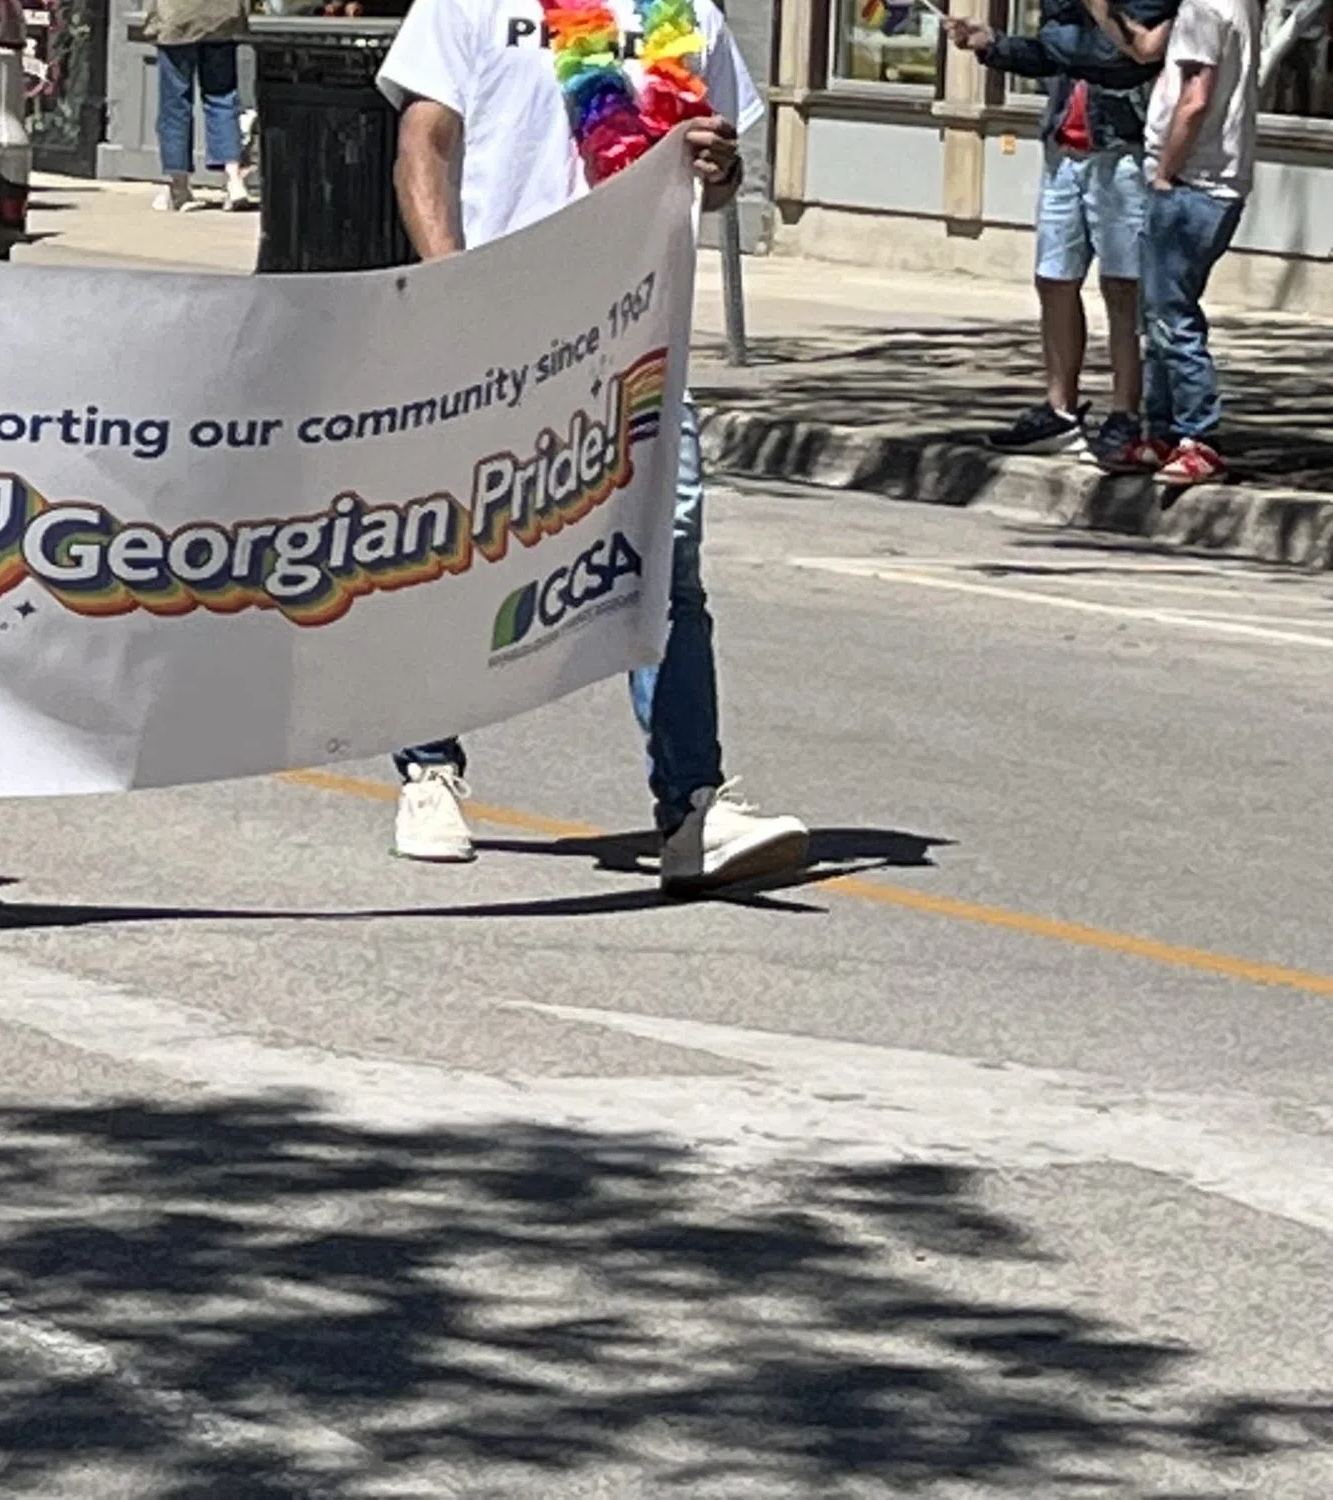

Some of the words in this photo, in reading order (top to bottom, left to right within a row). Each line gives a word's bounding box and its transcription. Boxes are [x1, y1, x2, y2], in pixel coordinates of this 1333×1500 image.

[190, 417, 284, 449] our
[297, 363, 530, 445] community
[534, 326, 600, 384] since
[606, 271, 656, 340] 1967
[20, 493, 451, 599] Georgian
[473, 377, 623, 538] Pride!
